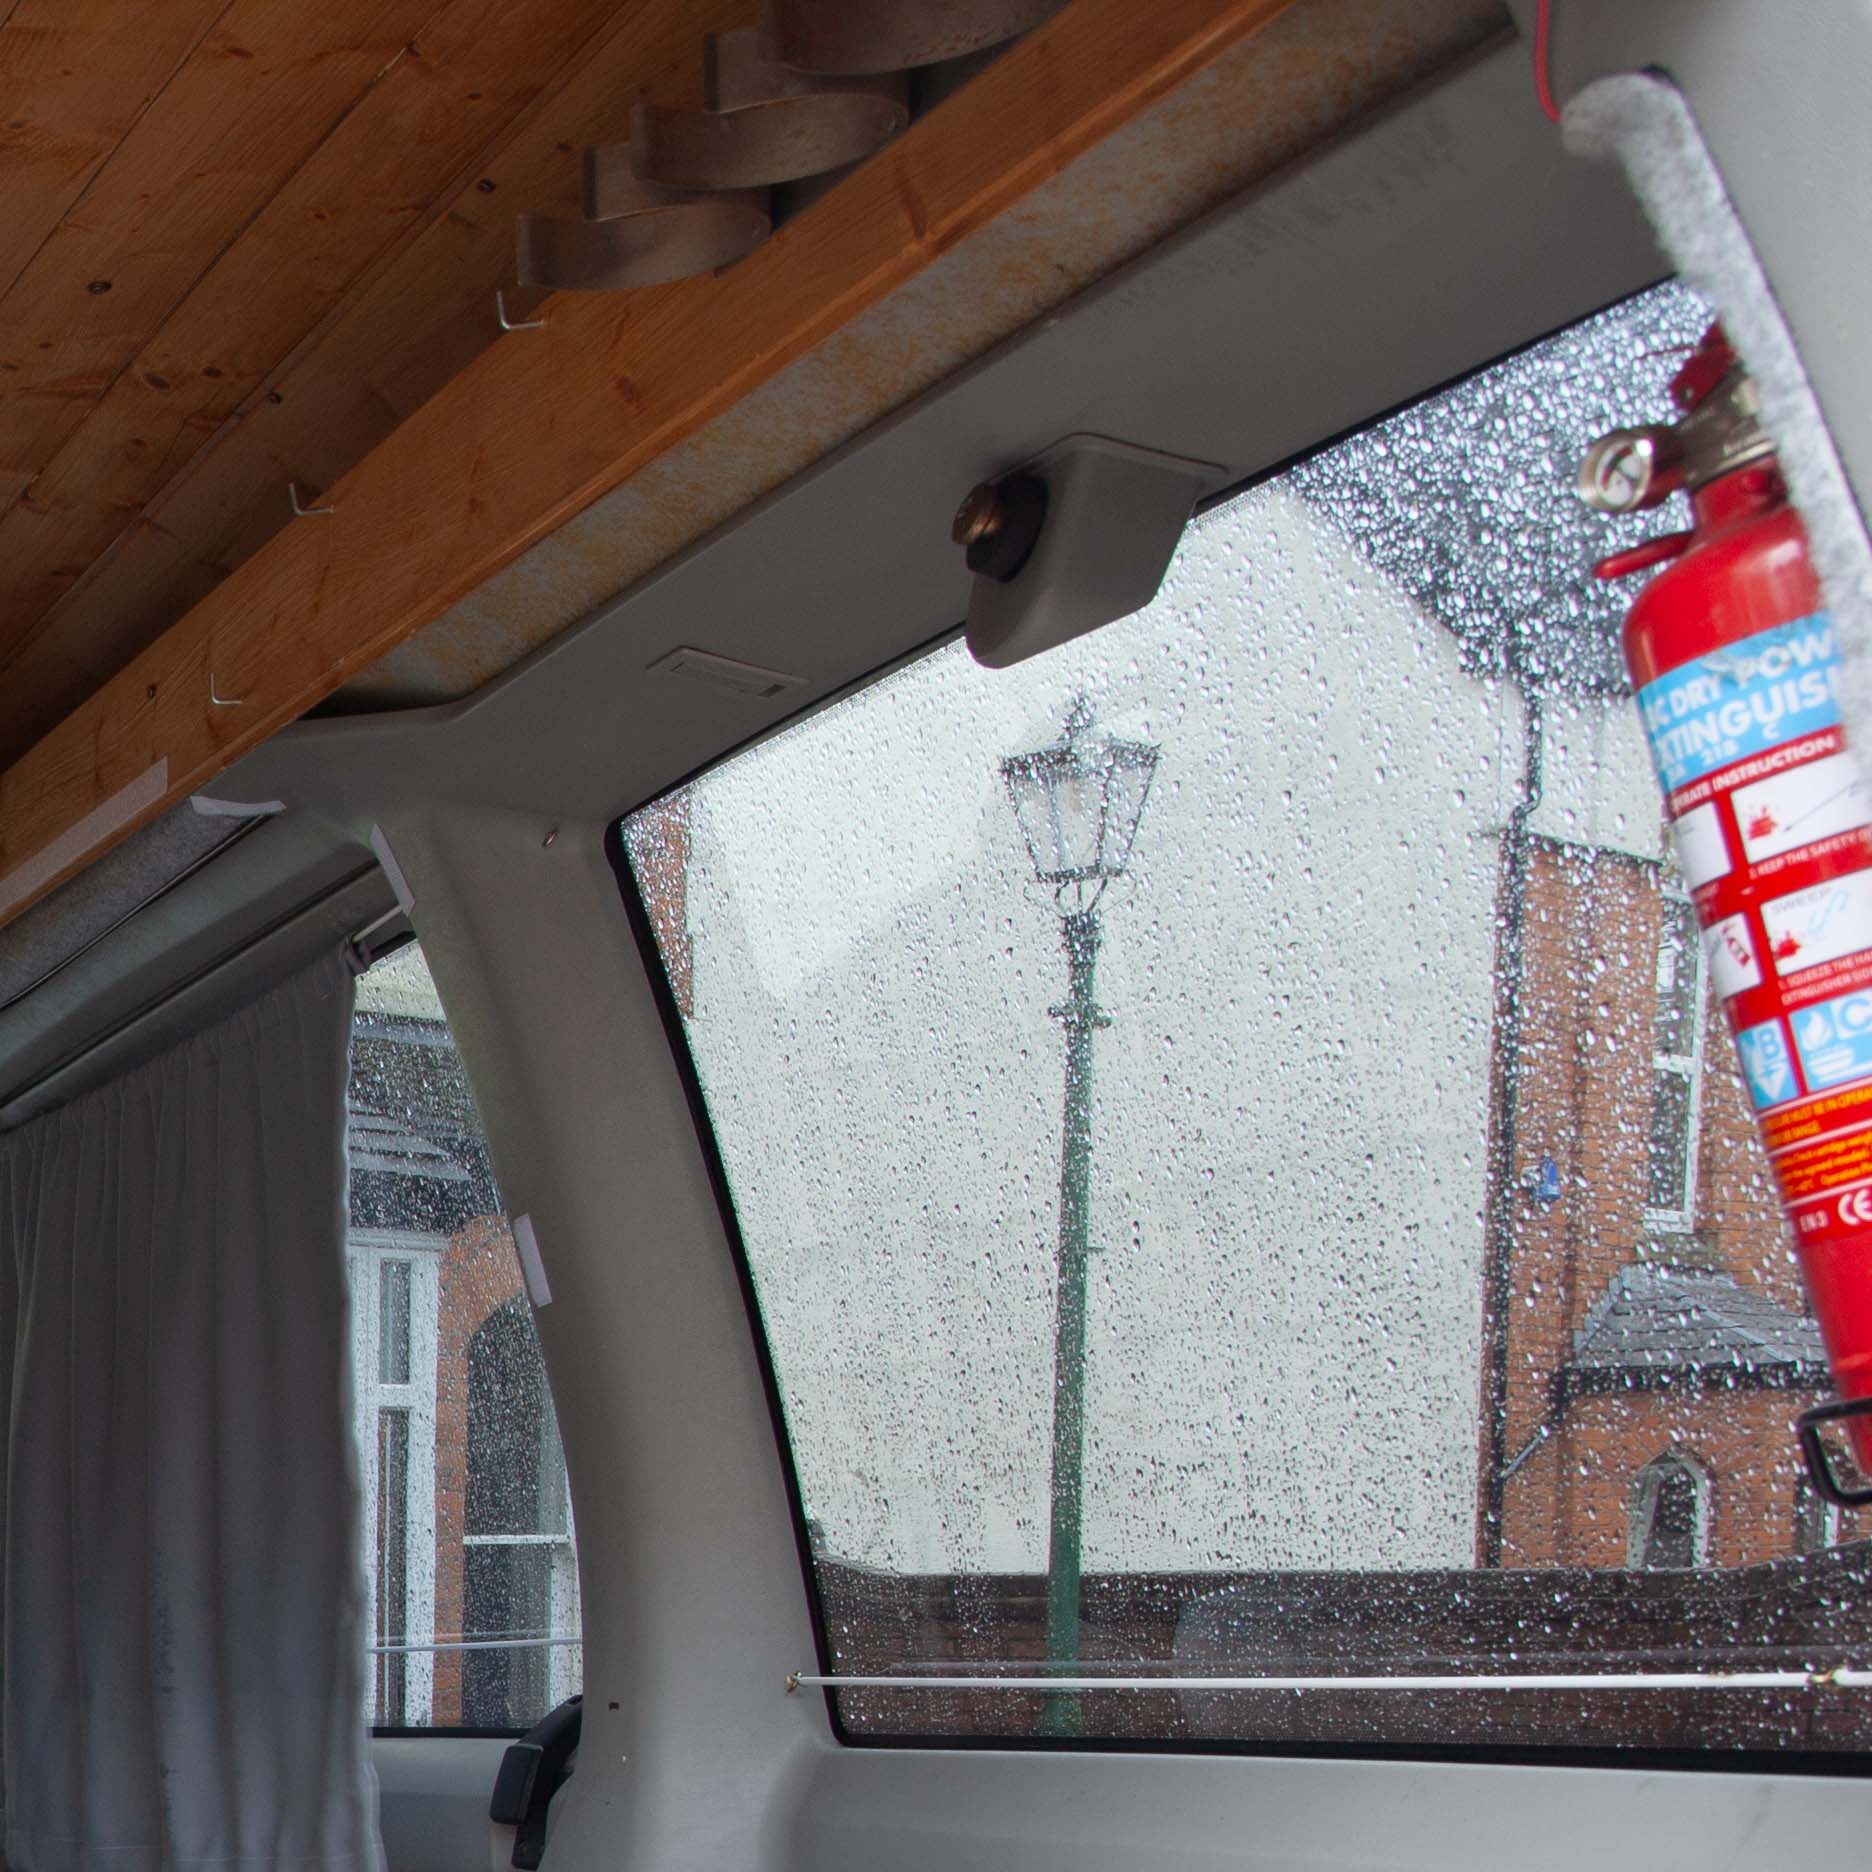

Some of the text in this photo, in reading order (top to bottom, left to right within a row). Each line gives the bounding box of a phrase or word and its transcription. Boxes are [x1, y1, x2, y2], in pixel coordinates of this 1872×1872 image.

[1669, 674, 1721, 717] DRY
[1762, 722, 1780, 740] C
[1712, 735, 1836, 791] INSTRUCTION
[1758, 856, 1784, 875] KEEP
[1785, 848, 1808, 865] THE
[1808, 832, 1856, 856] SAFETY
[1787, 964, 1833, 987] SQUEEZE
[1832, 957, 1855, 972] THE
[1757, 998, 1871, 1060] B C
[1837, 1187, 1872, 1227] CE
